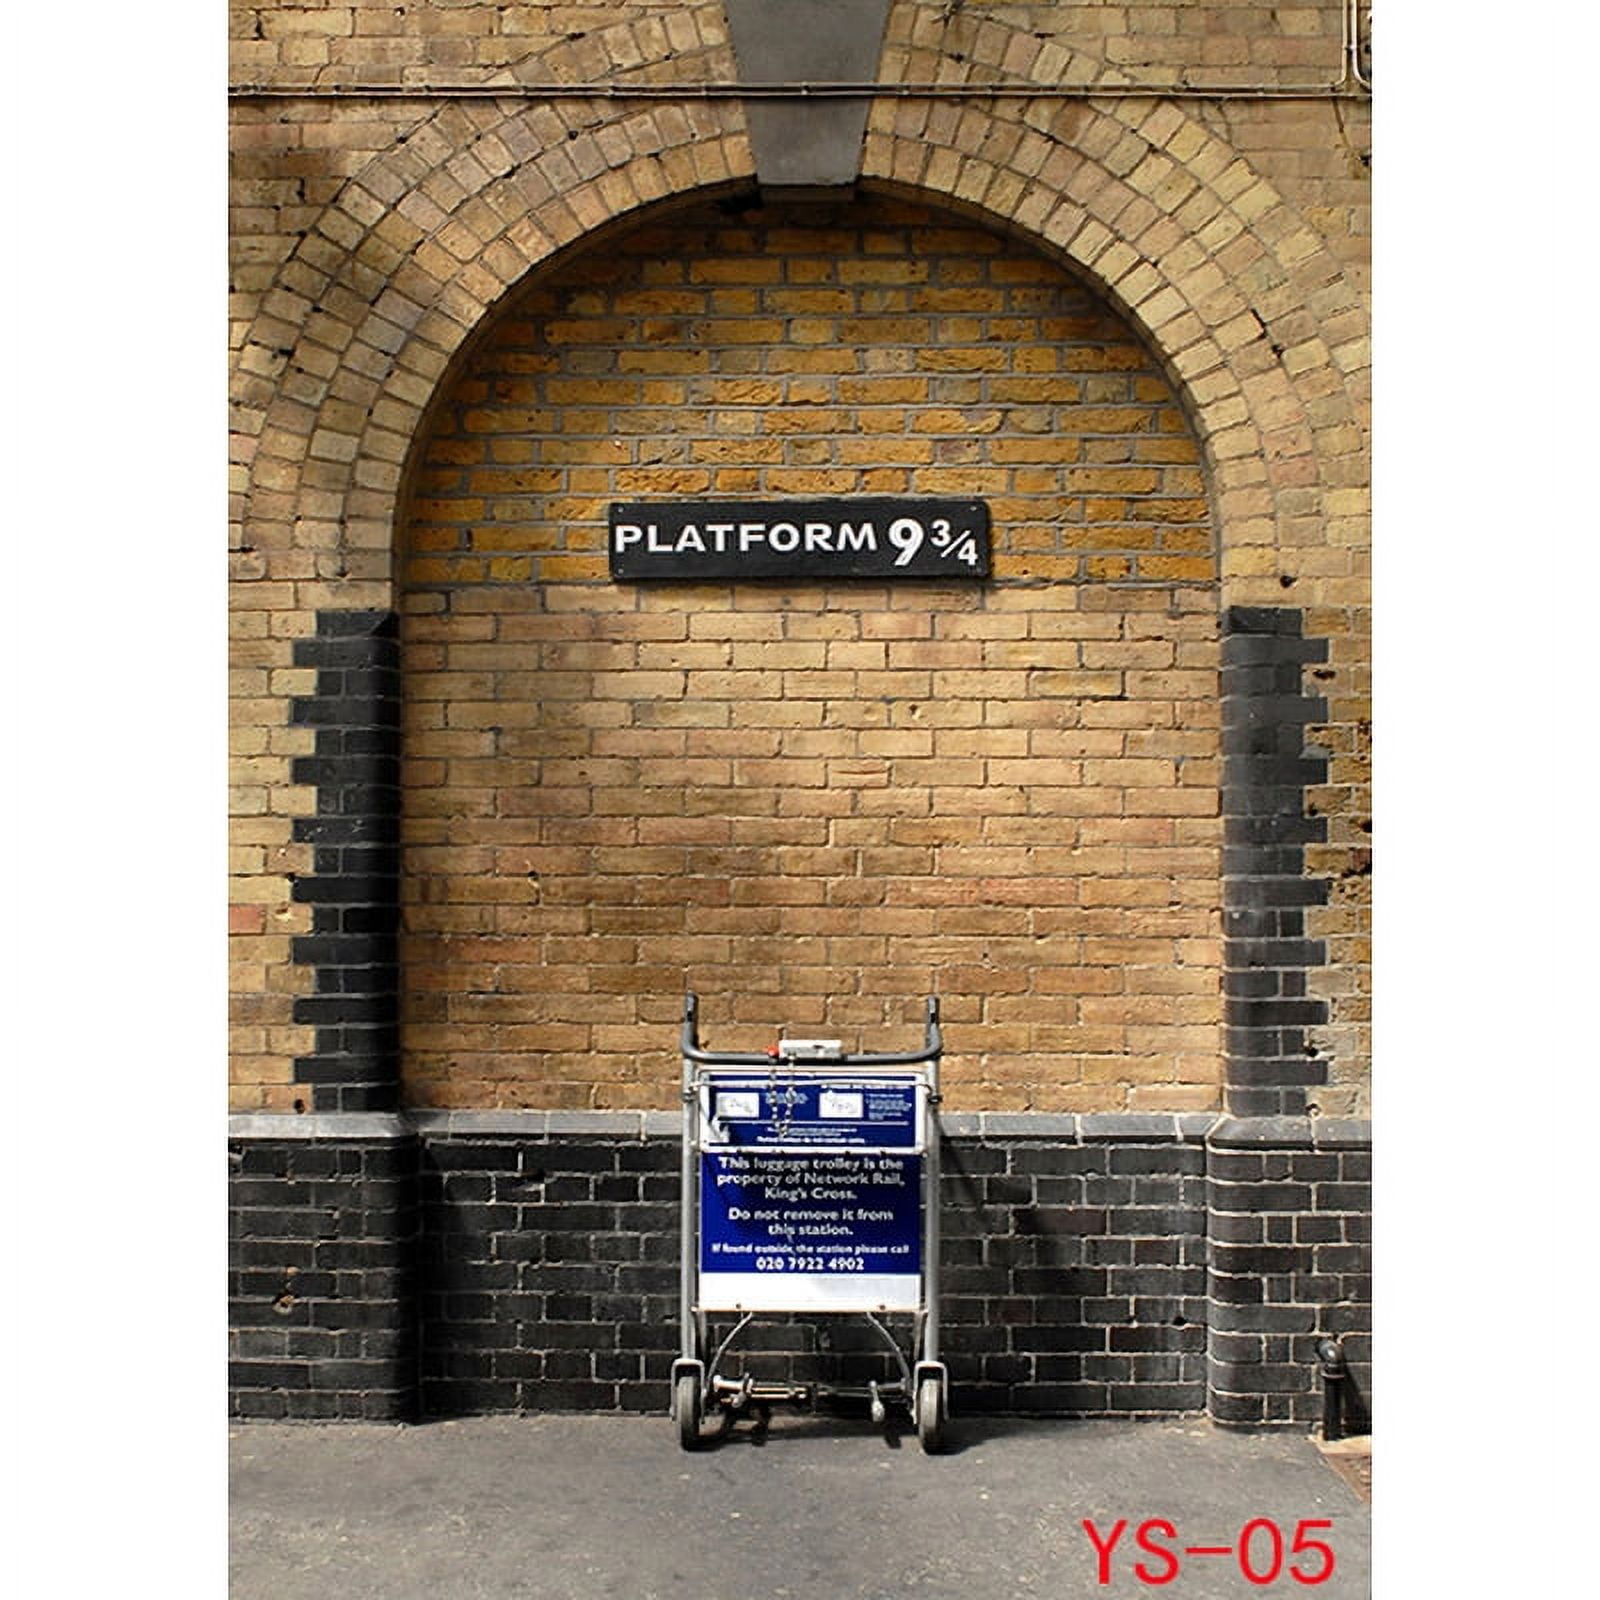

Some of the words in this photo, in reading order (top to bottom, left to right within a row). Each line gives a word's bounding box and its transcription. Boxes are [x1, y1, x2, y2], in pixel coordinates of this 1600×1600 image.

[615, 522, 878, 552] PLATFORM
[718, 1156, 749, 1169] This
[754, 1157, 809, 1171] luggage
[813, 1157, 860, 1172] trolley
[864, 1157, 875, 1169] is
[879, 1158, 903, 1170] the
[717, 1174, 781, 1186] property
[785, 1172, 801, 1184] of
[804, 1172, 869, 1184] Network
[872, 1174, 905, 1186] Rail,
[765, 1188, 807, 1202] King's
[811, 1188, 857, 1199] Cross.
[728, 1208, 750, 1220] Do
[754, 1208, 780, 1220] not
[784, 1211, 839, 1220] remove
[842, 1208, 854, 1220] it
[857, 1208, 894, 1220] from
[768, 1224, 795, 1235] this
[799, 1224, 853, 1235] station.
[712, 1244, 721, 1252] If
[722, 1244, 752, 1253] found
[795, 1244, 814, 1253] the
[816, 1244, 852, 1253] station
[854, 1245, 888, 1255] please
[890, 1245, 909, 1253] call
[756, 1257, 784, 1270] 020
[788, 1257, 824, 1270] 7922
[828, 1257, 864, 1270] 4902
